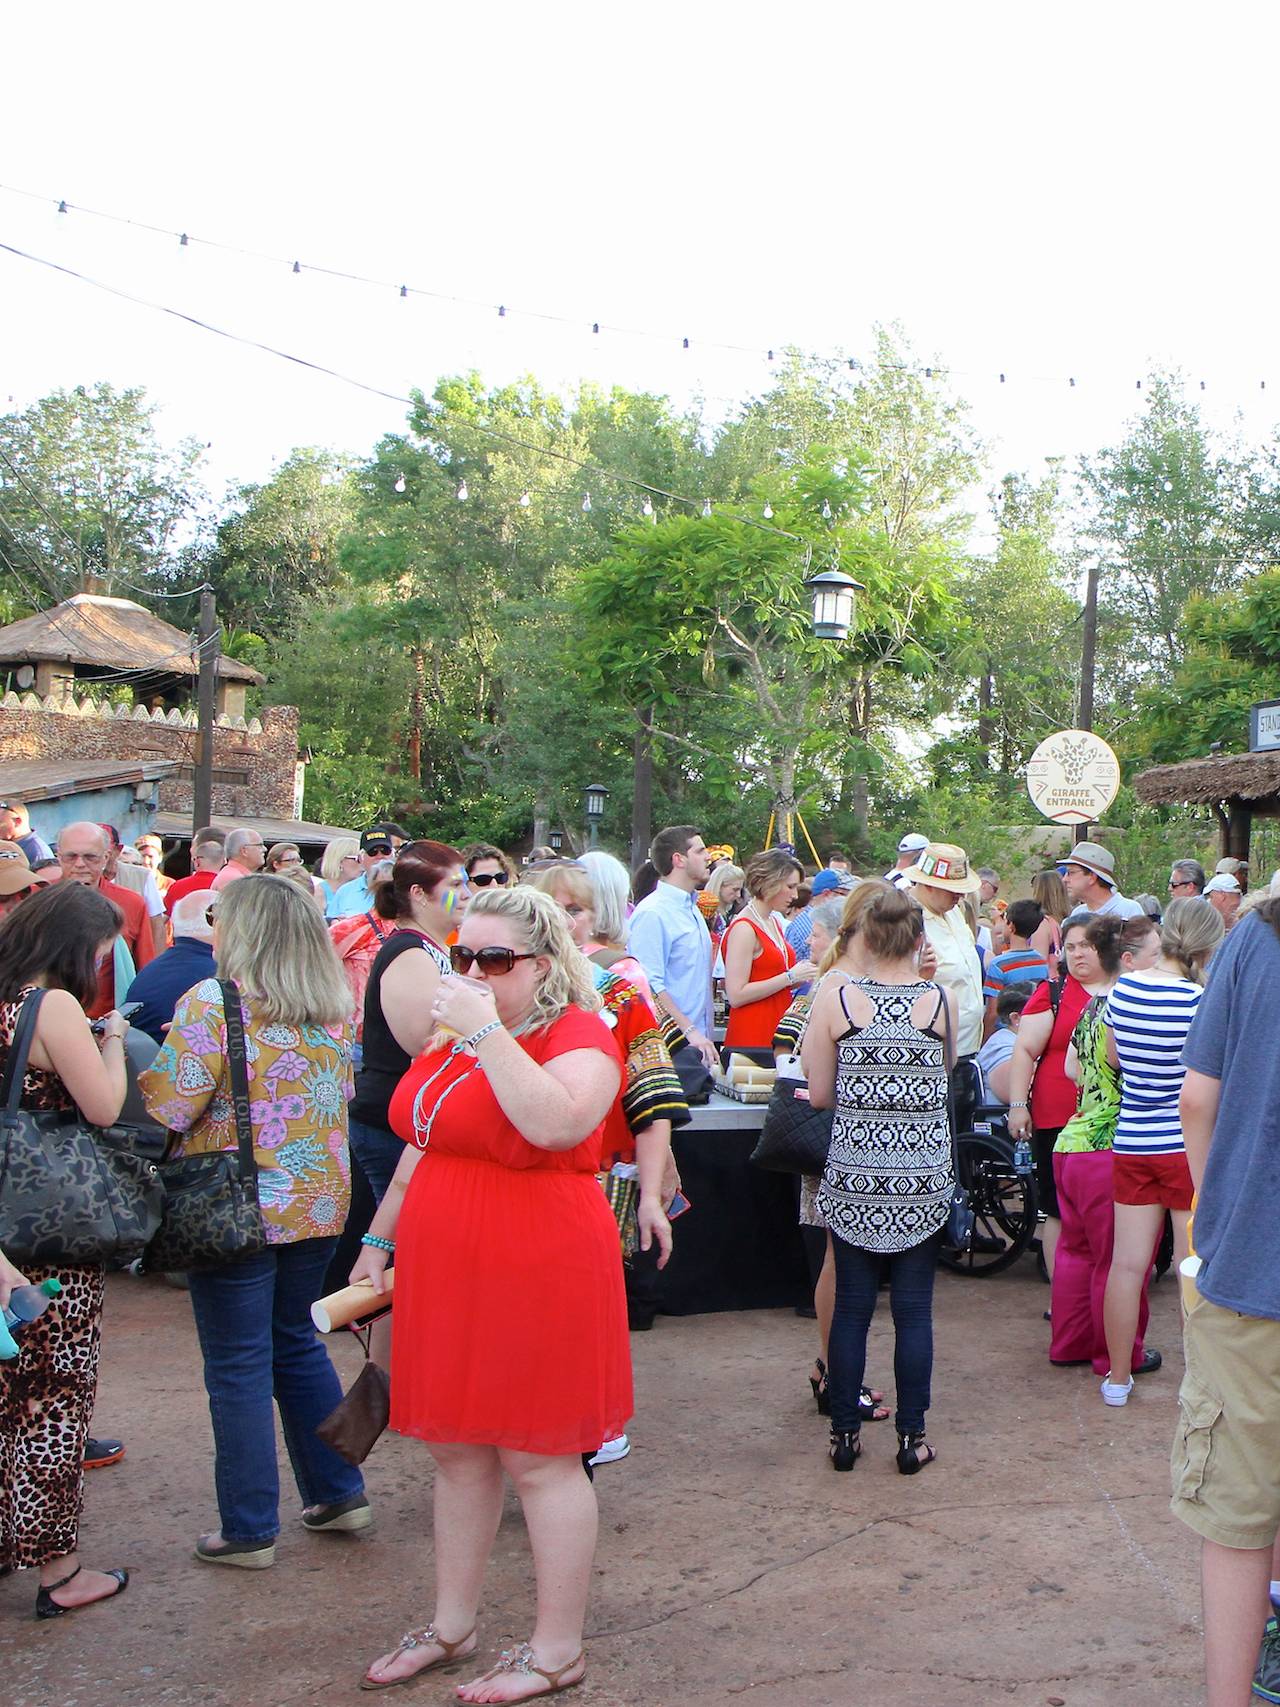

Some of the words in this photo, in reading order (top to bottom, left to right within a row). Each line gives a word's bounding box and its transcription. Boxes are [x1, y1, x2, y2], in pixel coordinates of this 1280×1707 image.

[1051, 788, 1090, 798] GIRAFFE
[1046, 798, 1096, 807] ENTRANCE
[237, 1096, 250, 1138] TOUS
